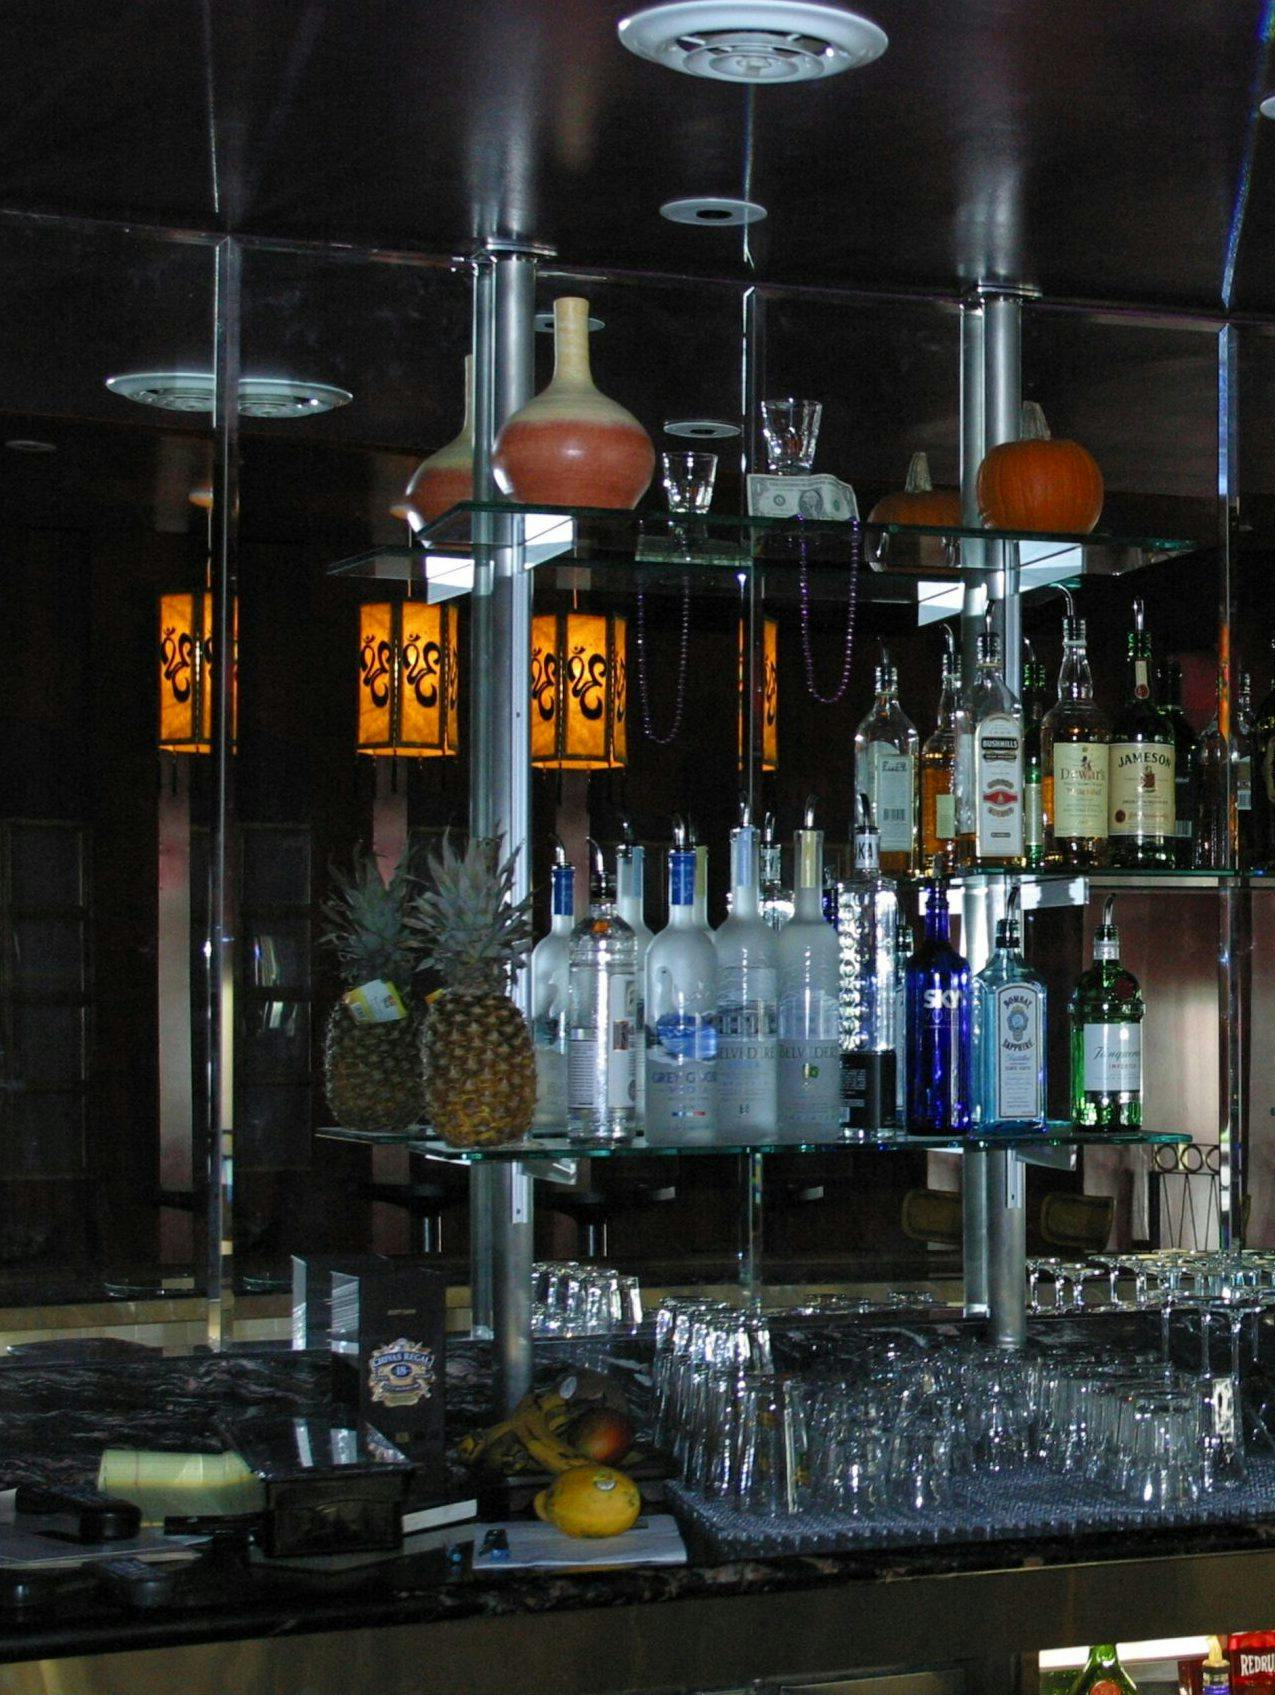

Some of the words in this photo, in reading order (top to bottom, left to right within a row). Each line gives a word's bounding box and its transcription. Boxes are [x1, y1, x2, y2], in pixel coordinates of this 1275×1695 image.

[982, 737, 1018, 749] BUSHMILLS
[1118, 752, 1172, 768] JAMESON
[1003, 995, 1033, 1009] BOMBAY
[1001, 1038, 1036, 1052] SAPPHIRE
